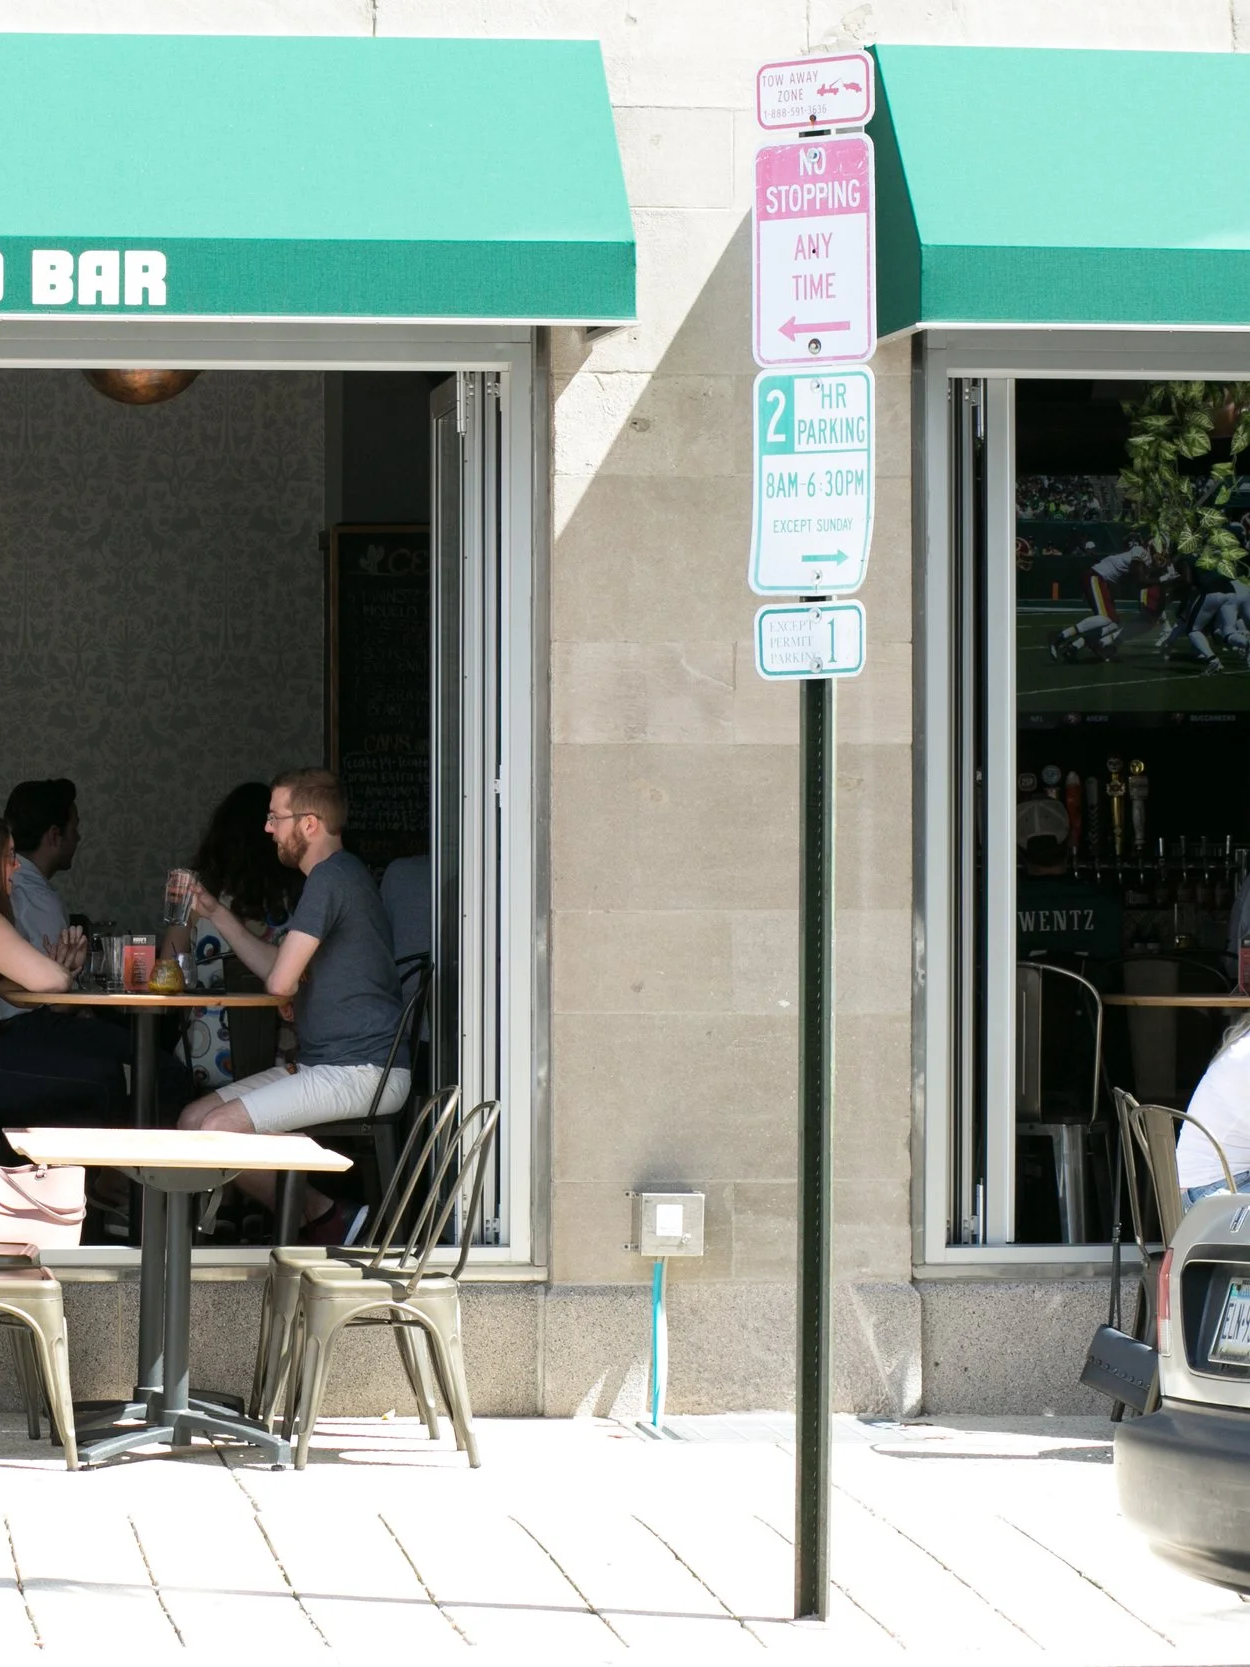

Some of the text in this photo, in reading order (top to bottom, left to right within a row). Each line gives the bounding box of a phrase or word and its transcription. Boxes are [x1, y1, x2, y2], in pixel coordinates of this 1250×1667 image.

[762, 70, 819, 88] TOW AWAY
[777, 88, 804, 103] ZONE
[764, 103, 827, 120] 1-888-591-3636
[799, 146, 827, 176] NO
[765, 179, 861, 214] STOPPING
[794, 232, 833, 261] ANY
[31, 249, 167, 306] BAR
[792, 272, 837, 301] TIME
[821, 382, 847, 409] HR
[766, 388, 786, 443] 2
[797, 415, 865, 445] PARKING
[773, 517, 853, 534] EXCEPT SUNDAY
[770, 619, 814, 633] EXCEPT
[827, 617, 838, 663] 1
[770, 635, 815, 649] PERMIT
[1018, 909, 1095, 932] WENTZ
